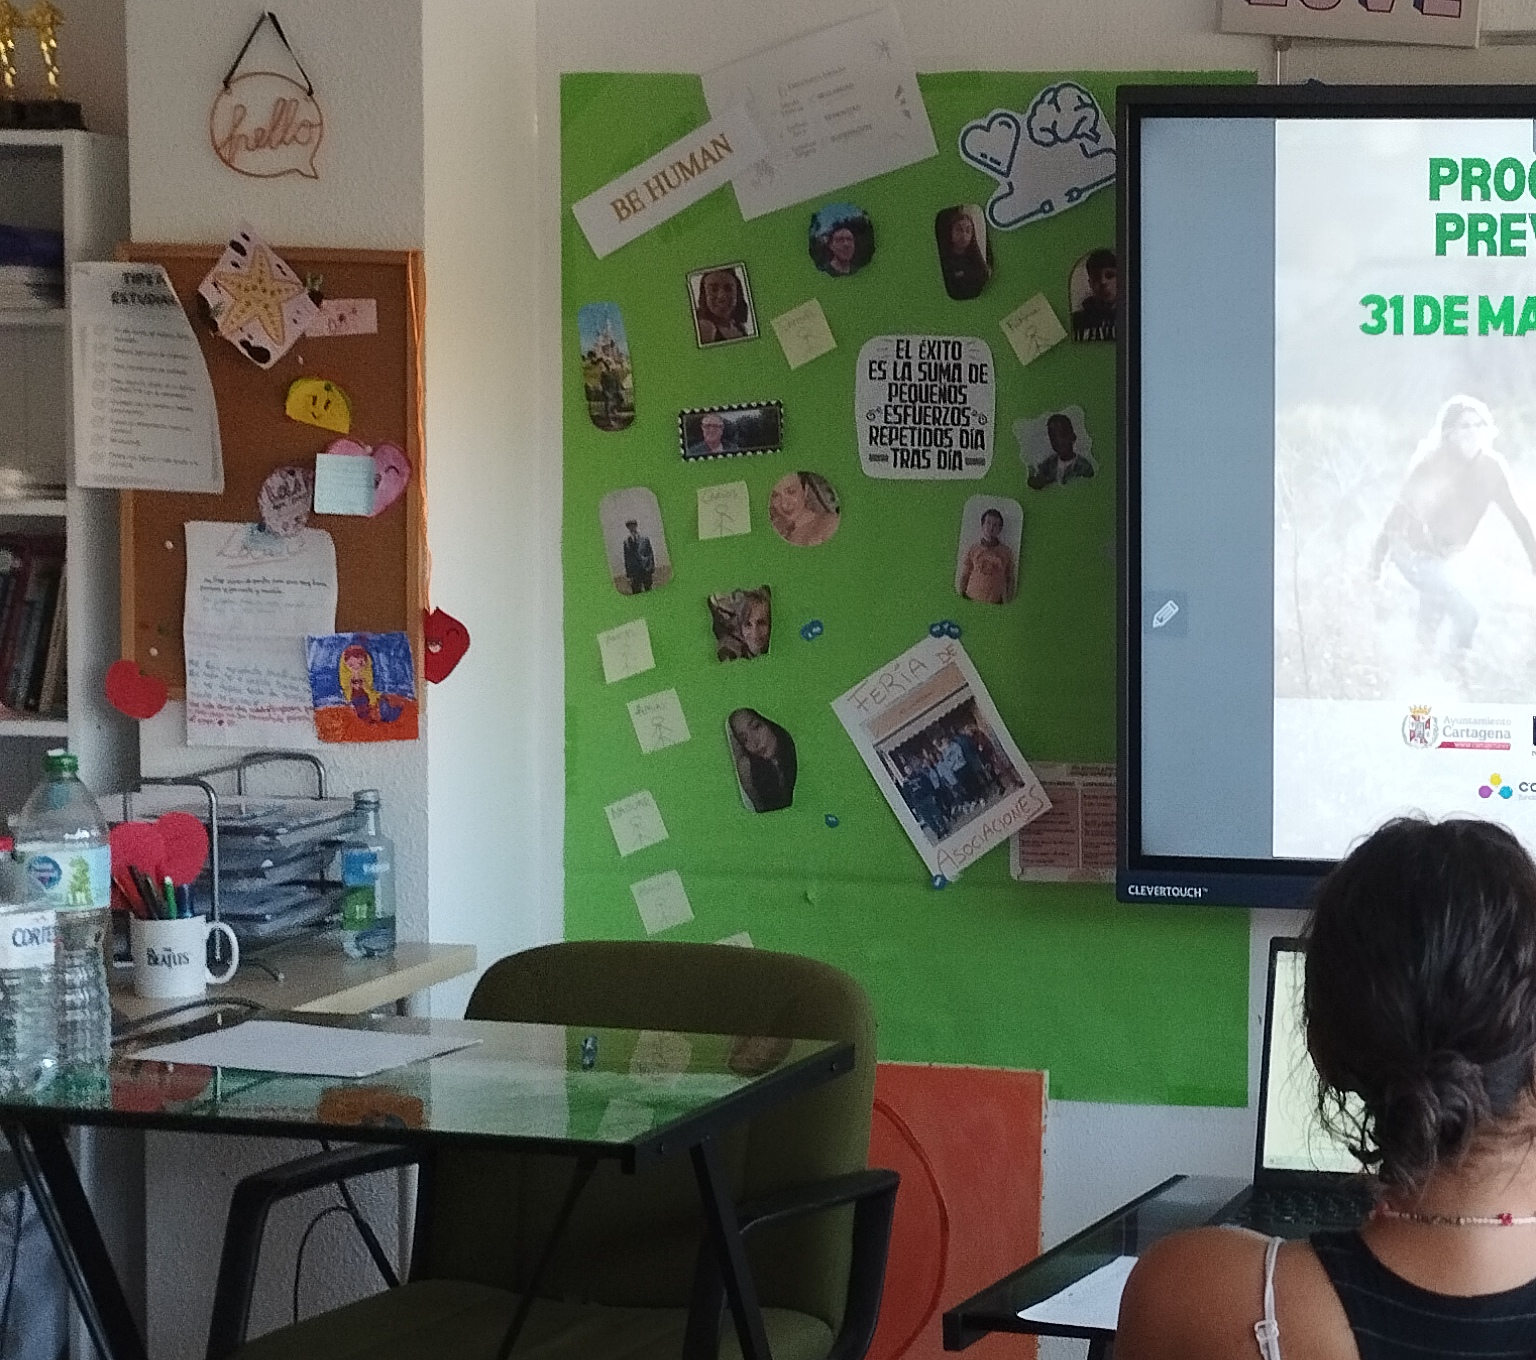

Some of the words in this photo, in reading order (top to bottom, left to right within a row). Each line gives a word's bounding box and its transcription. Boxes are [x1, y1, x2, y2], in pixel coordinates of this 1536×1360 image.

[609, 187, 645, 223] BE
[643, 132, 734, 200] HUMAN
[1359, 294, 1401, 336] 31
[1413, 295, 1469, 336] DE
[896, 339, 912, 360] EL
[918, 338, 962, 361] ÉXITO
[868, 360, 887, 381] ES
[893, 361, 912, 382] LA
[918, 362, 962, 383] SUMA
[968, 363, 988, 384] DE
[884, 404, 971, 427] ESFUERZOS
[868, 425, 953, 448] REPETIDOS
[959, 427, 985, 451] DÍA
[890, 447, 931, 469] TRAS
[937, 448, 963, 471] DÍA
[1442, 725, 1512, 741] Cartagena
[1443, 715, 1512, 727] Ayuntamiento
[936, 785, 1044, 875] ASOCIACIONES
